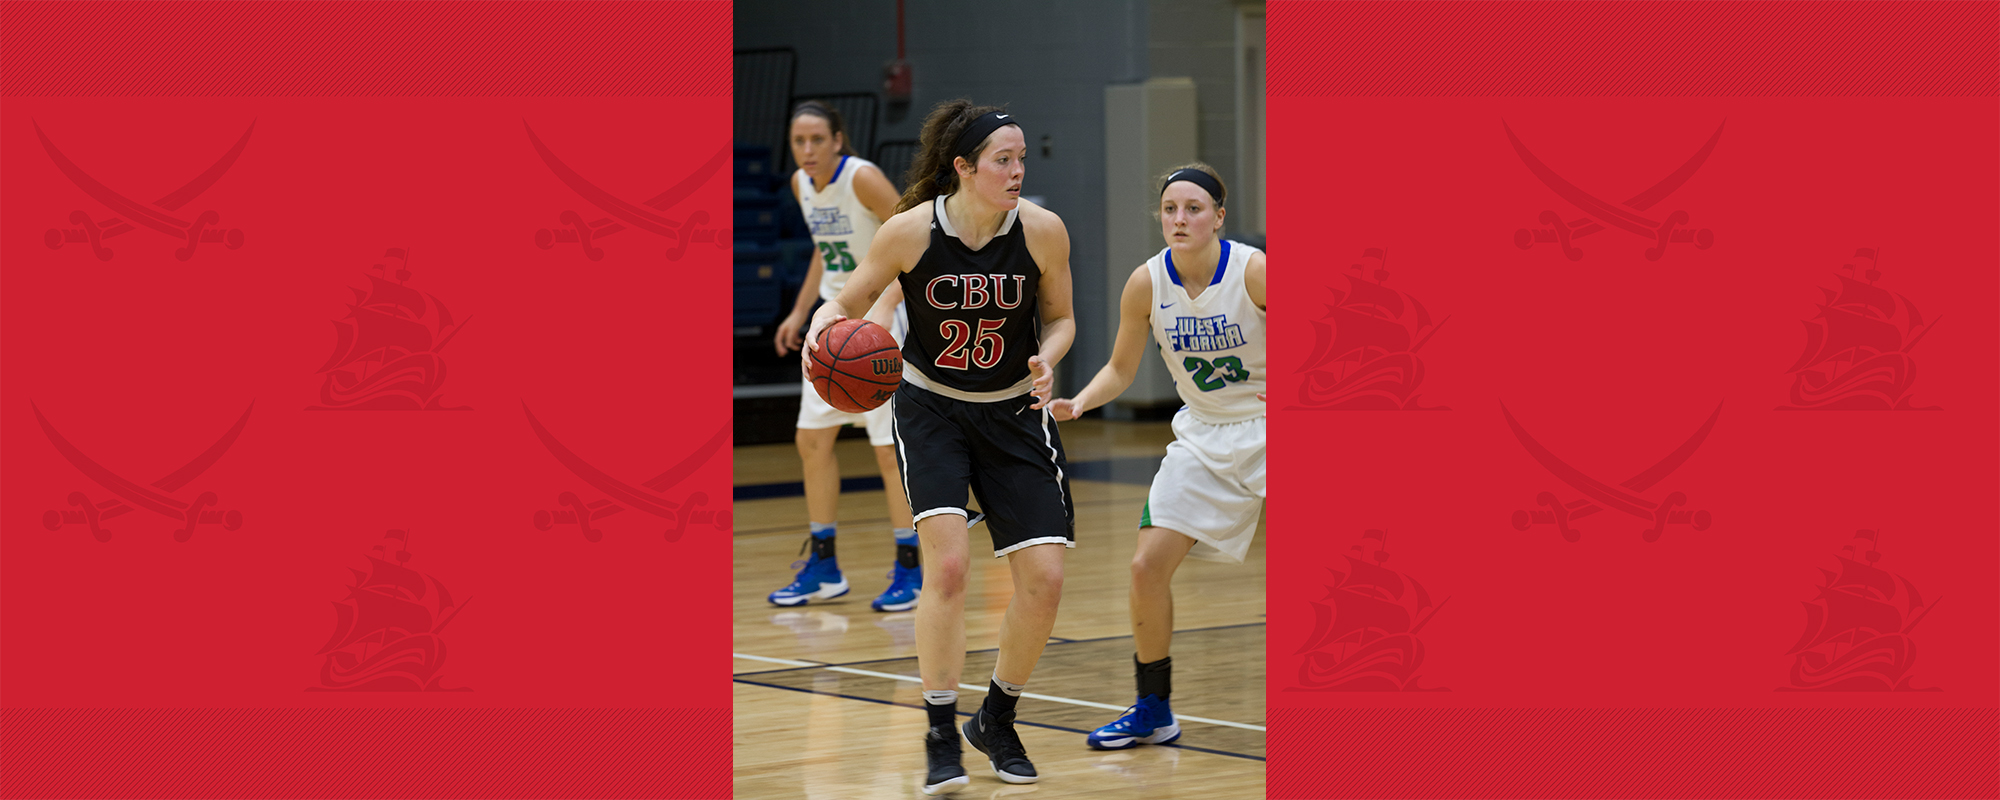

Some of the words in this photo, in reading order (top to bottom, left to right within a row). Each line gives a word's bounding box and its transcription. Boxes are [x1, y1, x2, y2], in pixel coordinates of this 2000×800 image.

[819, 241, 857, 272] 25
[925, 274, 1026, 310] CBU
[1165, 324, 1247, 352] FLORIDA
[1176, 314, 1226, 336] WEST
[934, 317, 1007, 370] 25
[1182, 355, 1250, 392] 23
